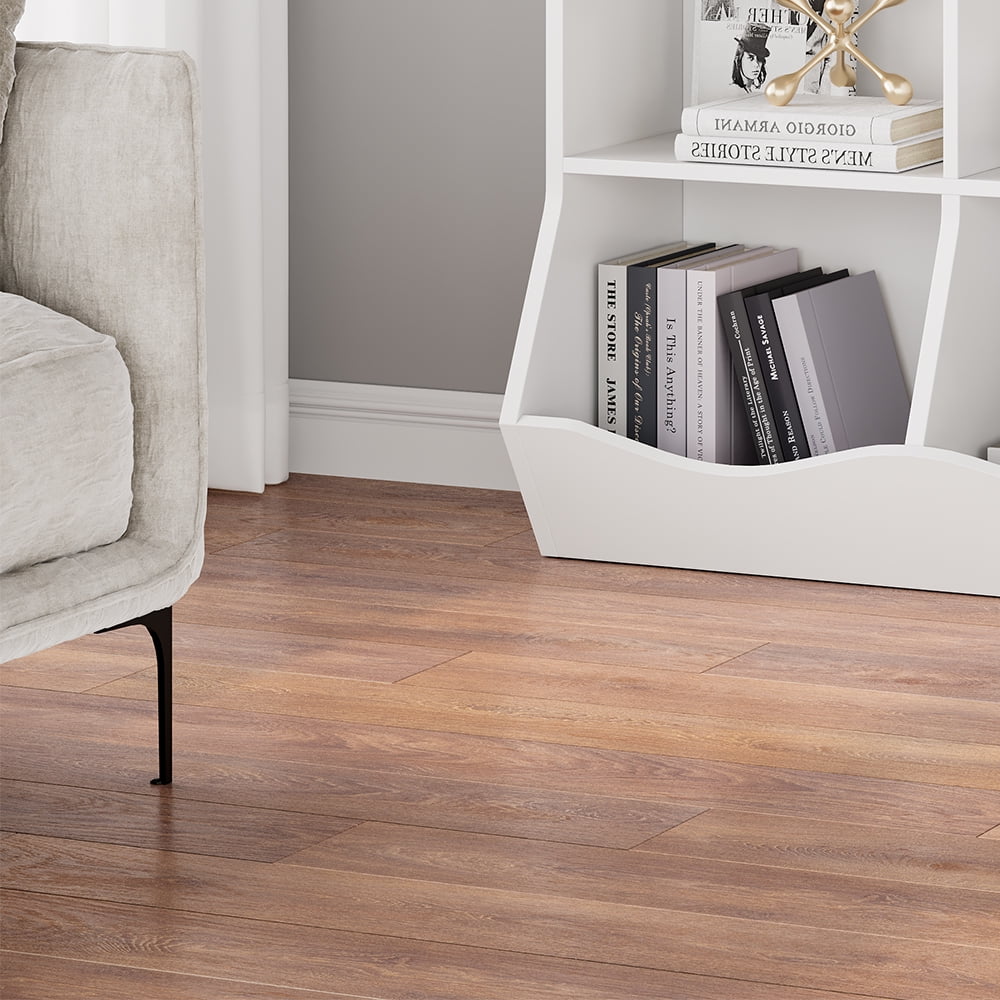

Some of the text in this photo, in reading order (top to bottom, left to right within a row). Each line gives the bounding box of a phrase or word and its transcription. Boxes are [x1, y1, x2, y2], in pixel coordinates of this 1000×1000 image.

[607, 279, 617, 310] THE
[634, 311, 643, 333] The
[731, 311, 740, 339] Cochran
[607, 313, 617, 362] STORE
[632, 335, 643, 375] Origins
[697, 357, 703, 368] OF
[745, 348, 754, 367] Print
[632, 377, 643, 392] of
[664, 317, 676, 434] Is This Anything?
[606, 377, 617, 425] JAMES
[634, 392, 643, 412] Our
[759, 405, 765, 413] in
[762, 413, 774, 443] Thought
[770, 445, 775, 453] of
